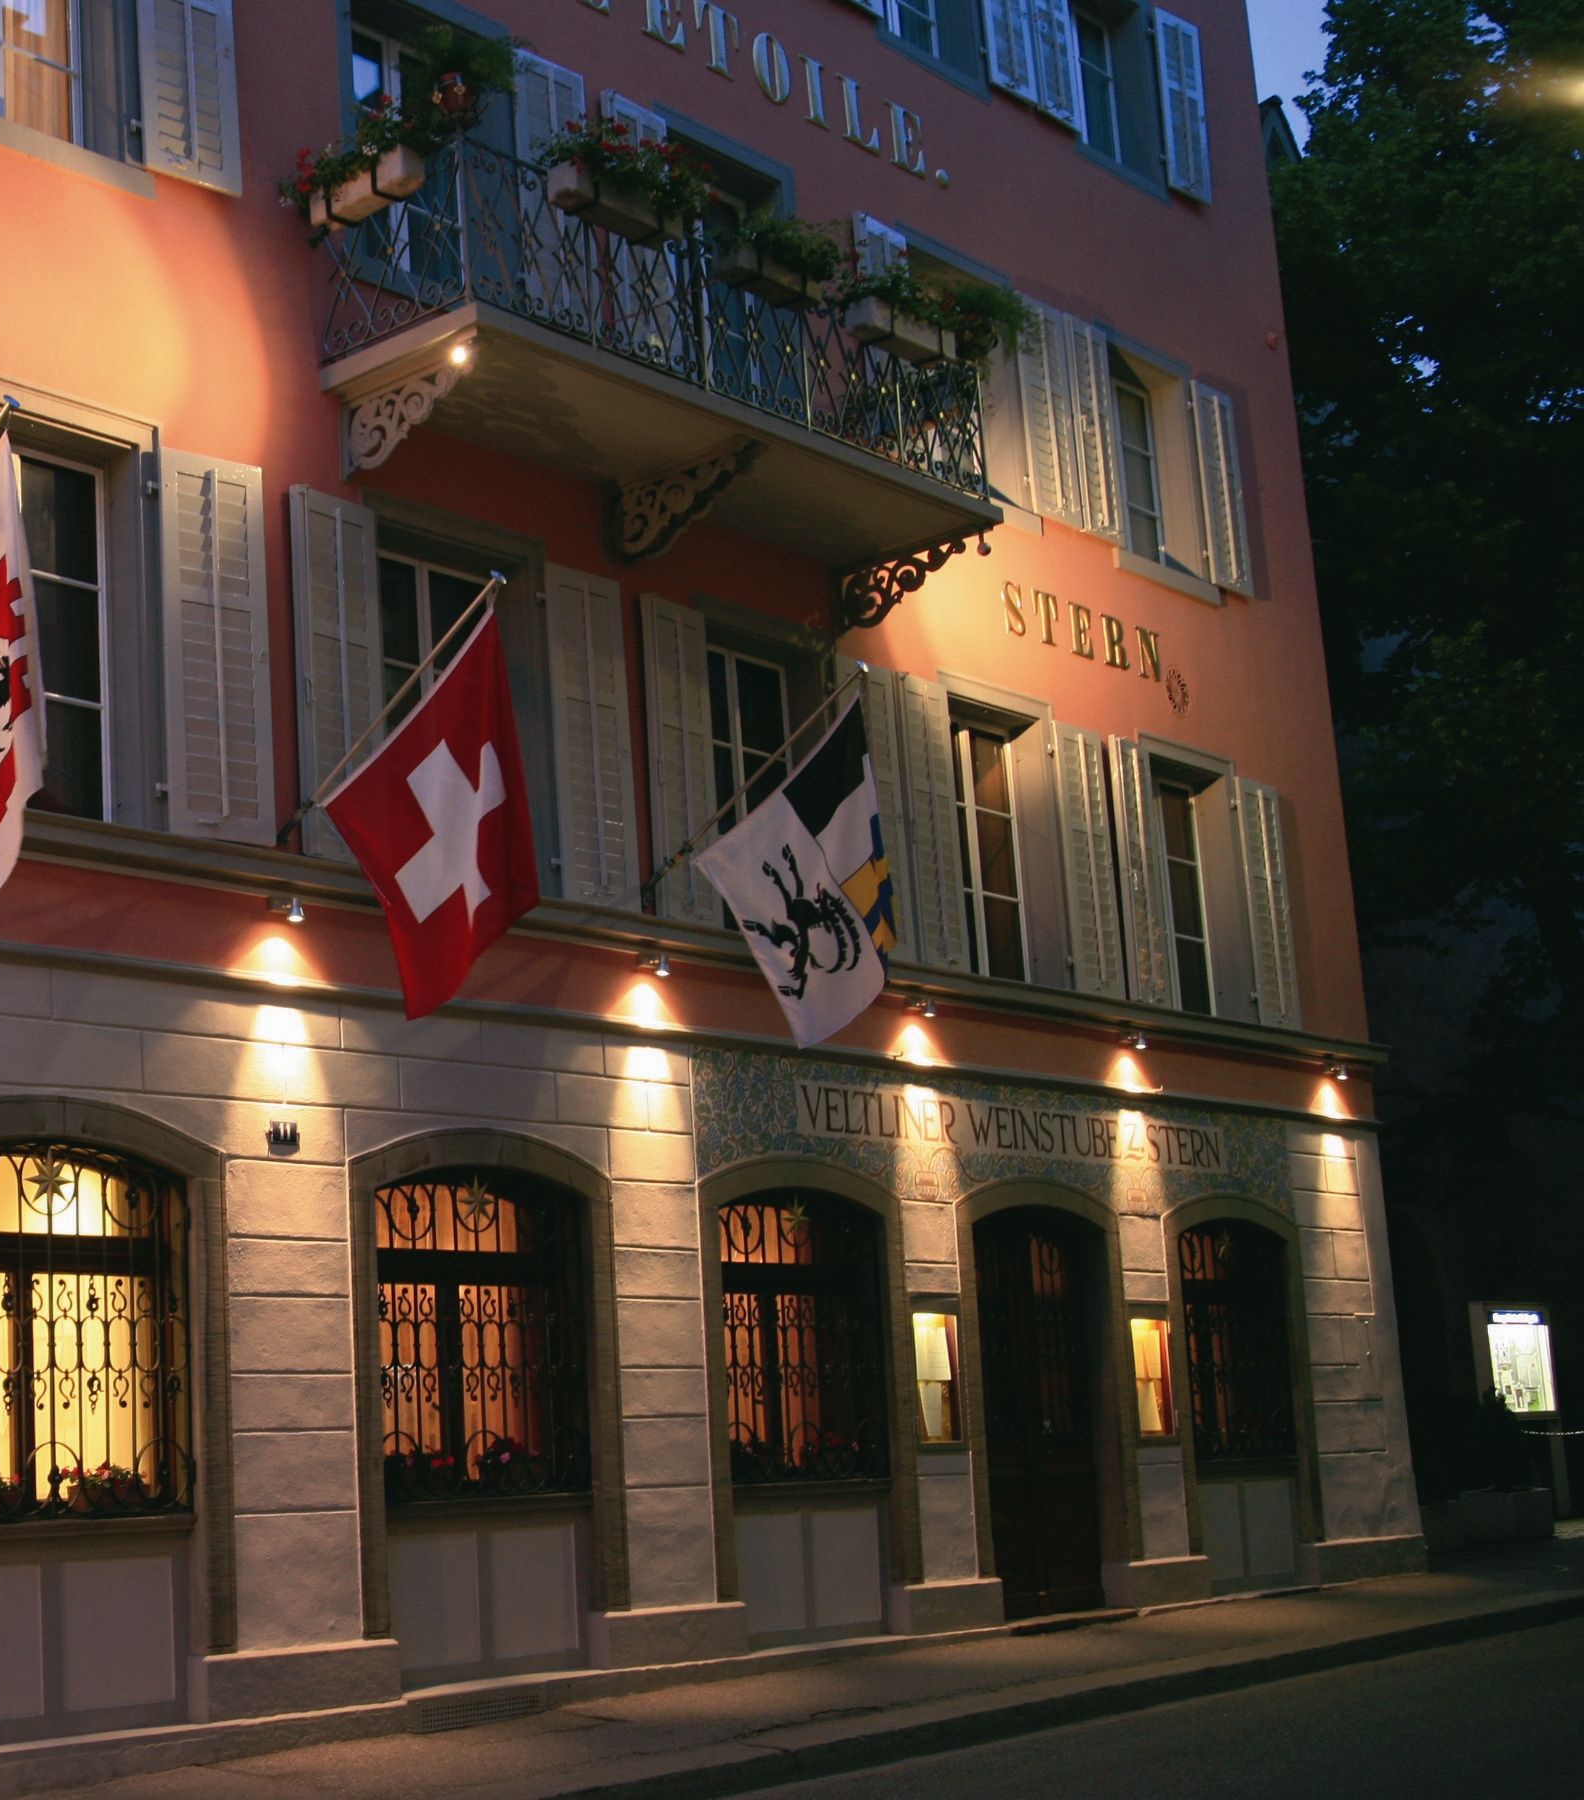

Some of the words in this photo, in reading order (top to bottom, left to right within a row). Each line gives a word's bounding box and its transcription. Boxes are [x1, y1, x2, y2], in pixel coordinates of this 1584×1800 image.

[1000, 580, 1161, 682] STERN
[800, 1085, 957, 1143] VELTLINER
[966, 1103, 1122, 1159] WEINSTUBE
[1146, 1122, 1222, 1167] STERN
